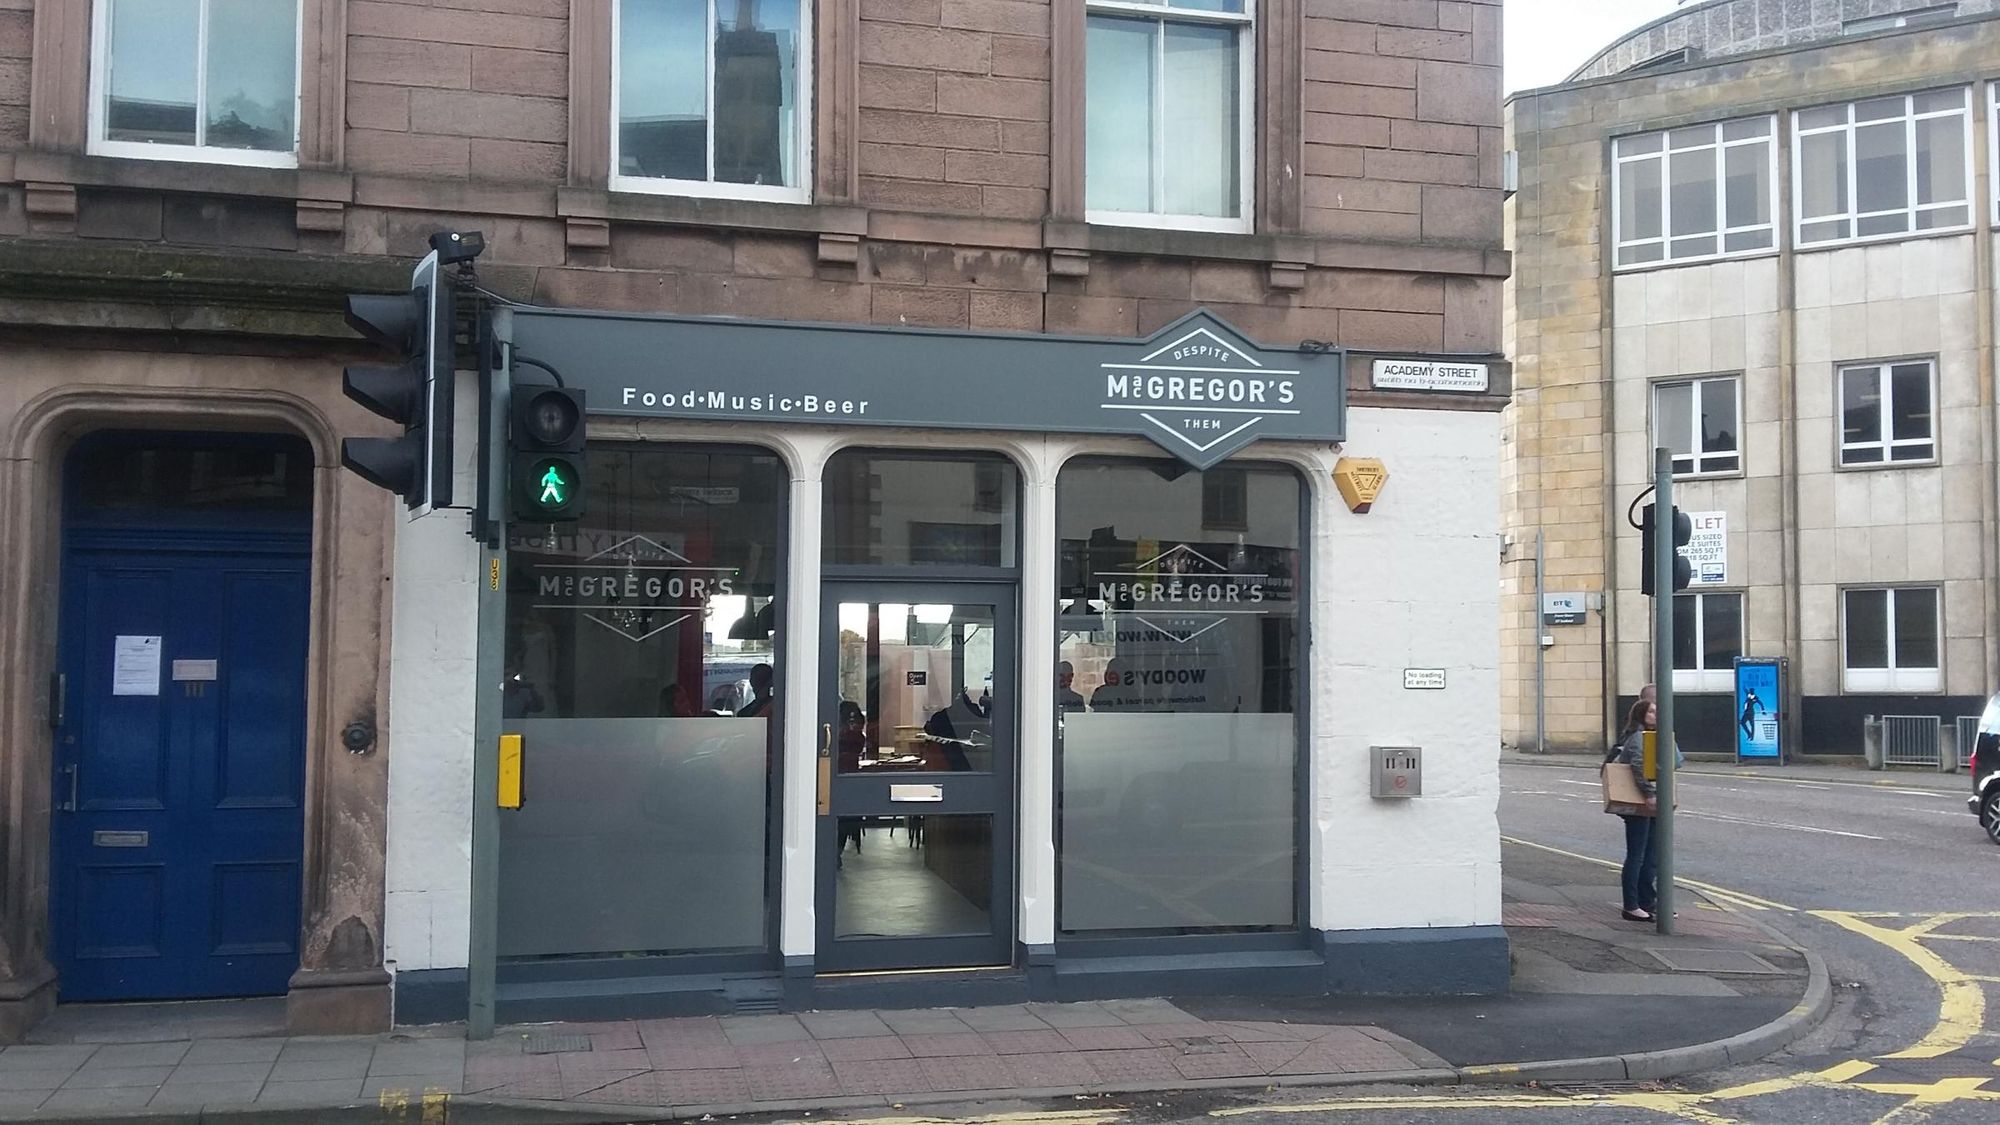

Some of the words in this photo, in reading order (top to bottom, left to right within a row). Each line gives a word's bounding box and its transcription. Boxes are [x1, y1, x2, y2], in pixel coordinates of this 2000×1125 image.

[1174, 345, 1230, 362] DESPITE
[1384, 365, 1434, 376] ACADEMY
[1438, 367, 1478, 378] STREET
[1184, 418, 1221, 430] THEM
[1695, 517, 1723, 529] LET
